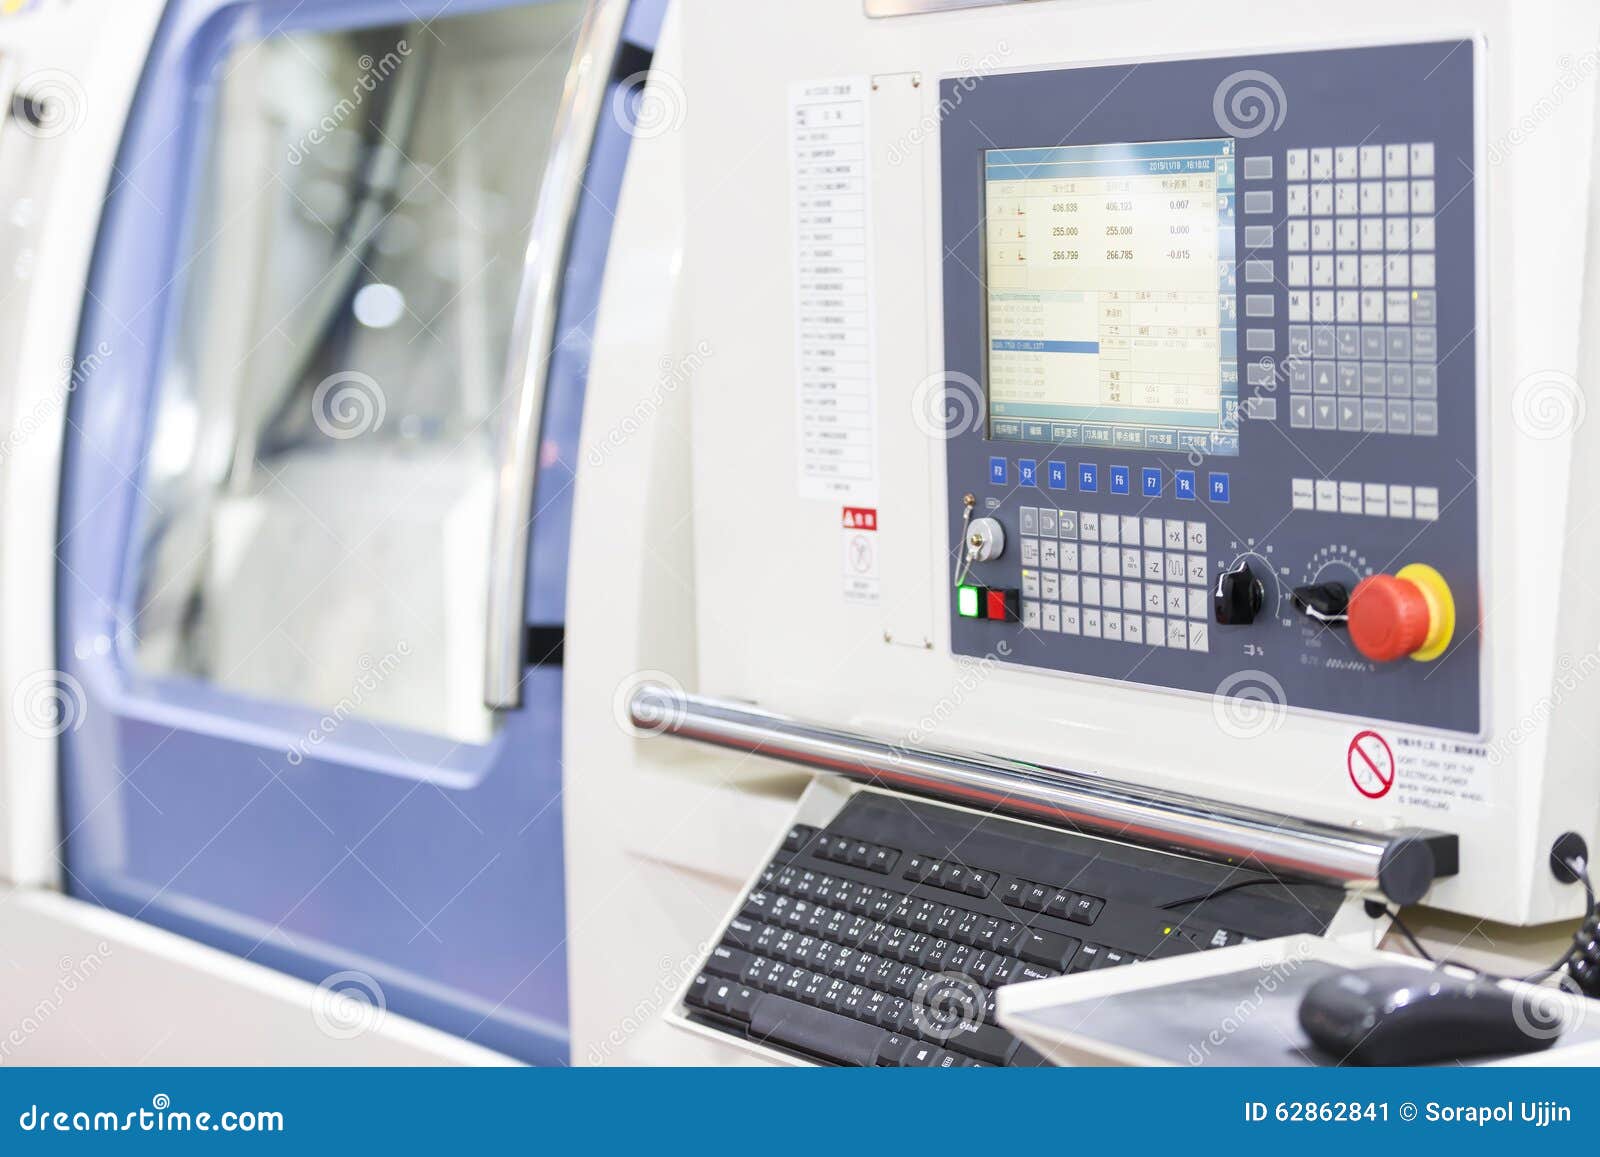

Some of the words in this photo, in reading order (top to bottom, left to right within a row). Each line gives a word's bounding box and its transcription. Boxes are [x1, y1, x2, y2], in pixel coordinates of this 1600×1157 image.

[1106, 226, 1133, 236] 255.000
[1106, 250, 1133, 260] 266.785
[1053, 471, 1062, 481] F4
[1084, 473, 1092, 483] F5
[1115, 475, 1124, 486] F6
[1147, 478, 1156, 488] F7
[1180, 480, 1190, 491] F8
[1214, 482, 1224, 494] F9
[1169, 532, 1180, 541] +X
[1192, 534, 1203, 545] +C
[1150, 563, 1160, 573] -Z
[1192, 568, 1204, 578] +Z
[1150, 595, 1159, 606] -C
